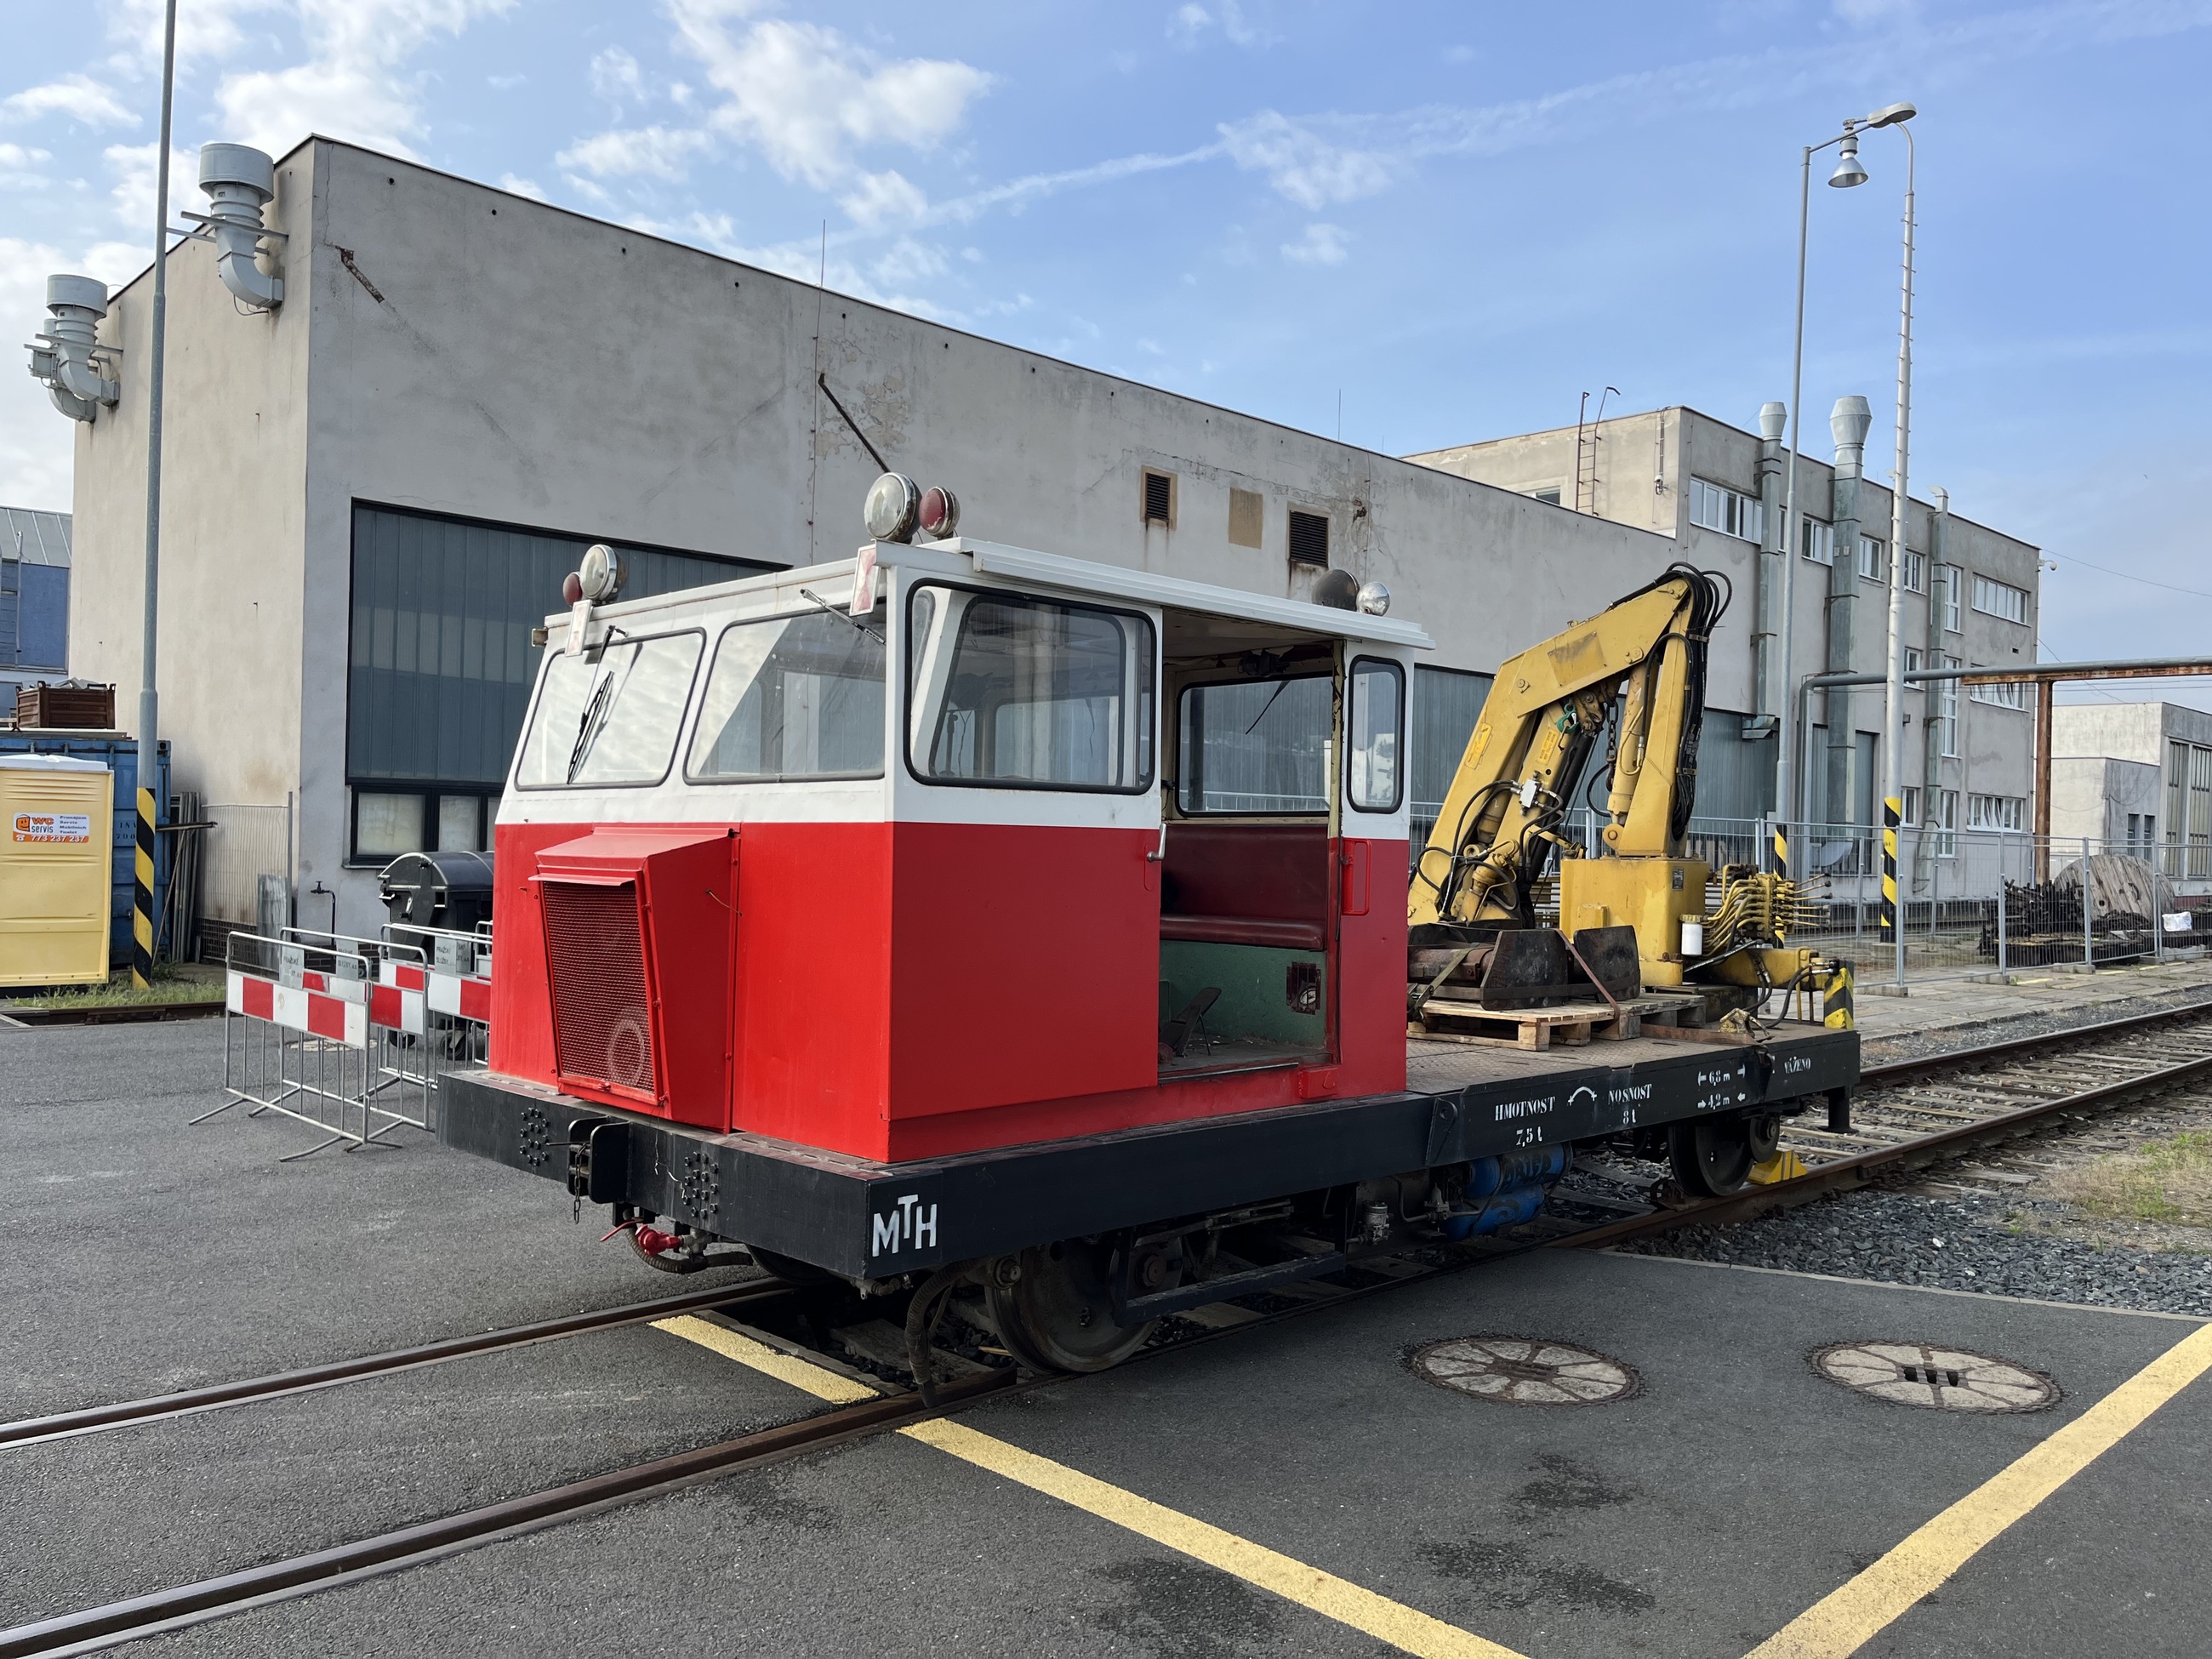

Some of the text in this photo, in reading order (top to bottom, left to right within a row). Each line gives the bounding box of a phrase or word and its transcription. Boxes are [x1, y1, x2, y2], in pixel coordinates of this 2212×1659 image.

[31, 824, 54, 834] servis
[1784, 1056, 1810, 1074] VÁŽENO
[1708, 1069, 1730, 1086] 6,8 m
[1608, 1083, 1652, 1105] NOSNOST
[1707, 1093, 1730, 1109] 4,2 m
[1495, 1096, 1556, 1121] HMOTNOST
[1622, 1109, 1637, 1125] 8 t
[1515, 1126, 1542, 1147] 7,5 t
[872, 1194, 938, 1257] MTH
